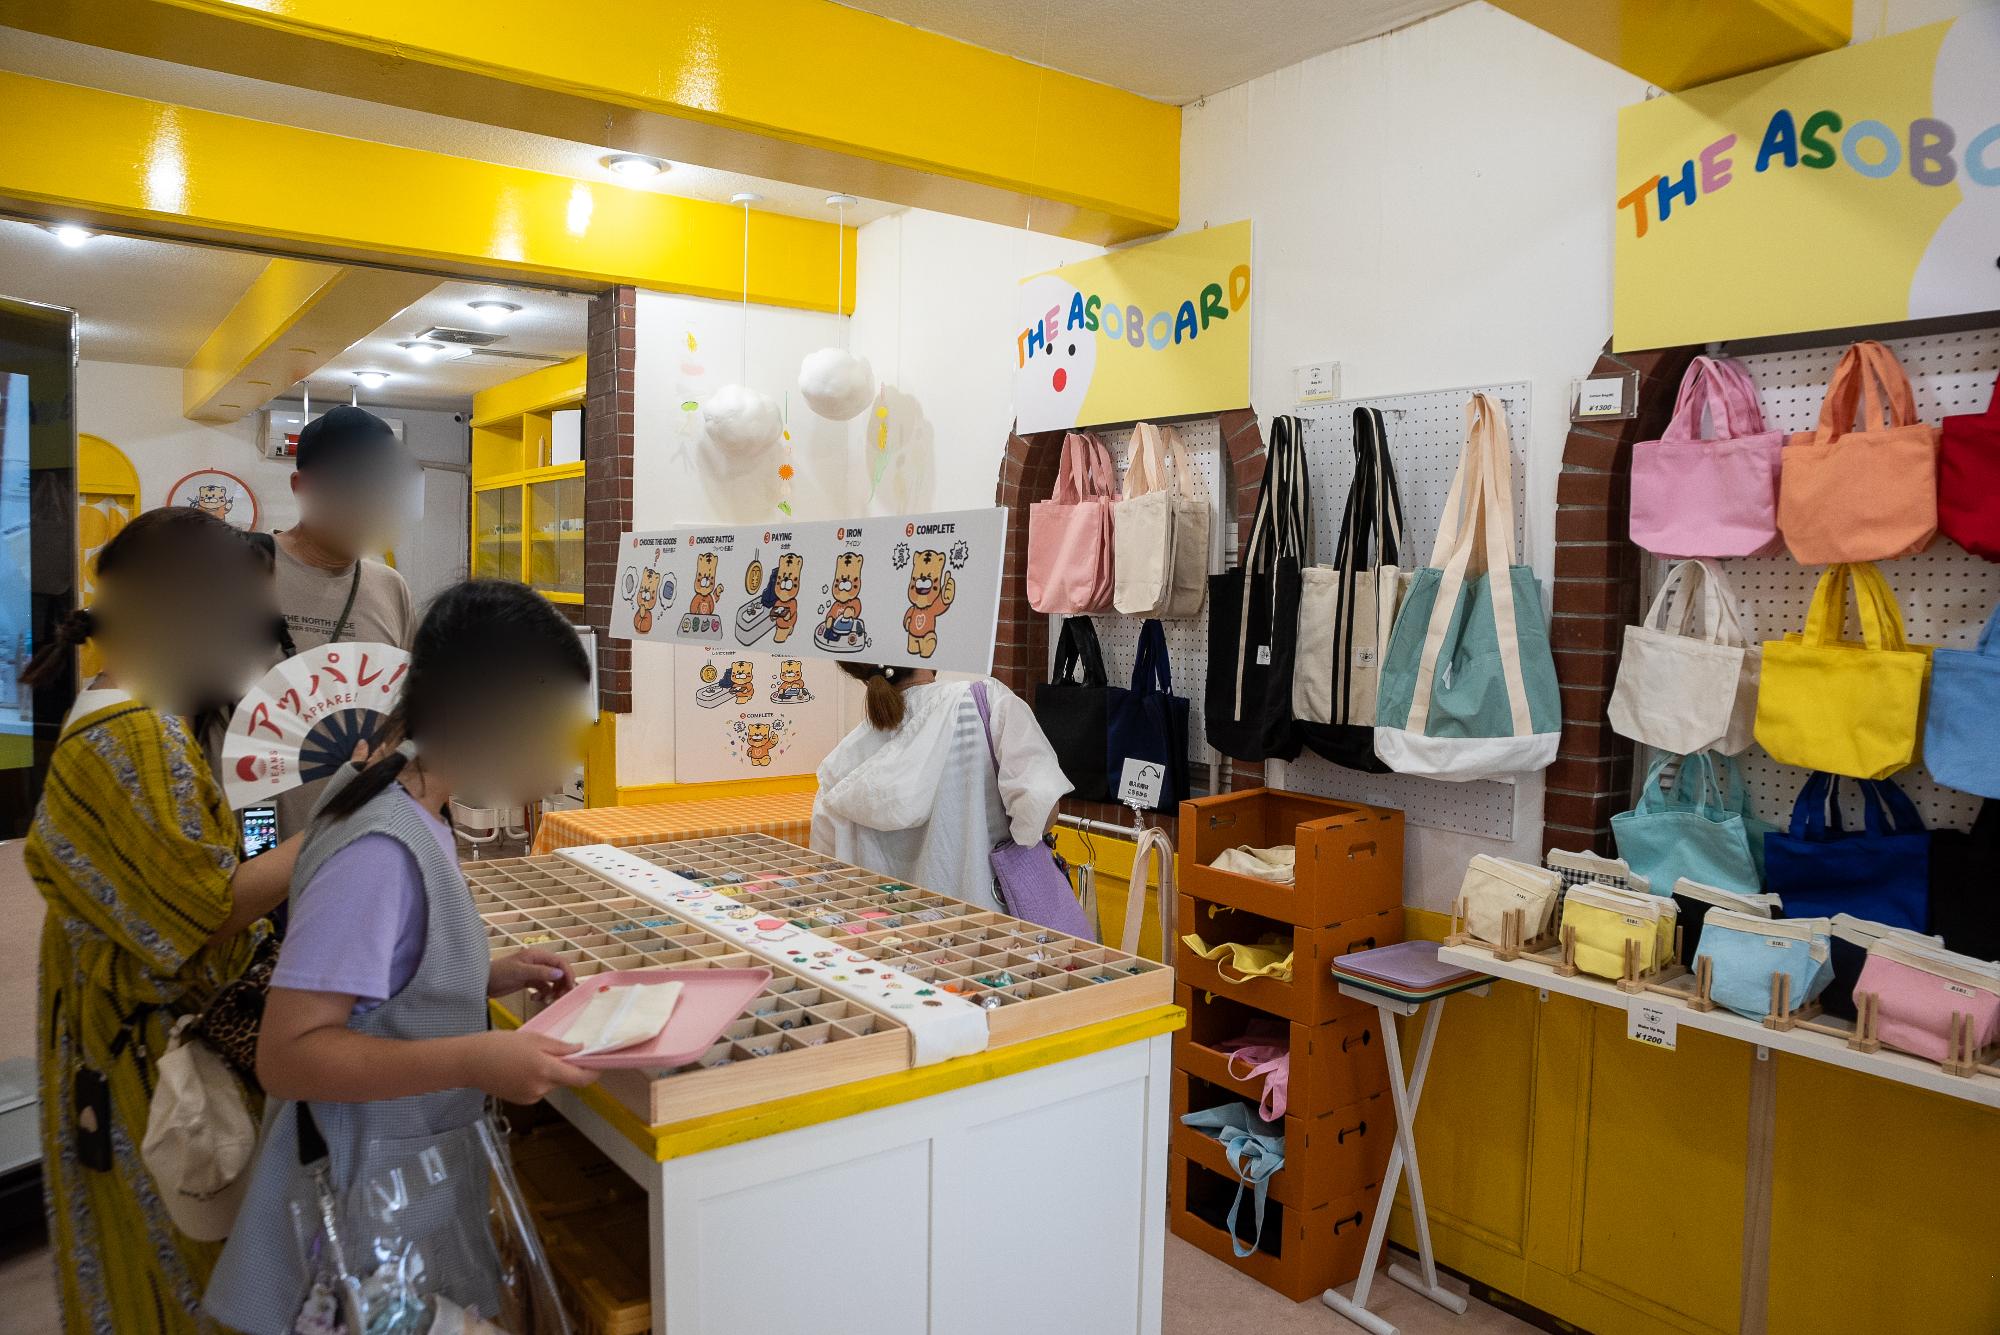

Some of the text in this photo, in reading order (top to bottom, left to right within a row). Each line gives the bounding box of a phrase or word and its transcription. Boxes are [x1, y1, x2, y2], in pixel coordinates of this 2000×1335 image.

[1618, 133, 1737, 238] THE
[1067, 264, 1250, 351] ASOBOARD
[846, 528, 862, 538] IRON
[916, 523, 955, 535] COMPLETE
[639, 538, 654, 546] CHOOSE
[663, 537, 677, 545] GOODS
[696, 536, 715, 544] CHOOSE
[771, 532, 792, 542] PAYING
[282, 614, 355, 629] THE NORTH FCE
[302, 692, 359, 723] APPARE!
[269, 749, 279, 784] BEAMS
[1636, 1032, 1662, 1044] ¥1200
